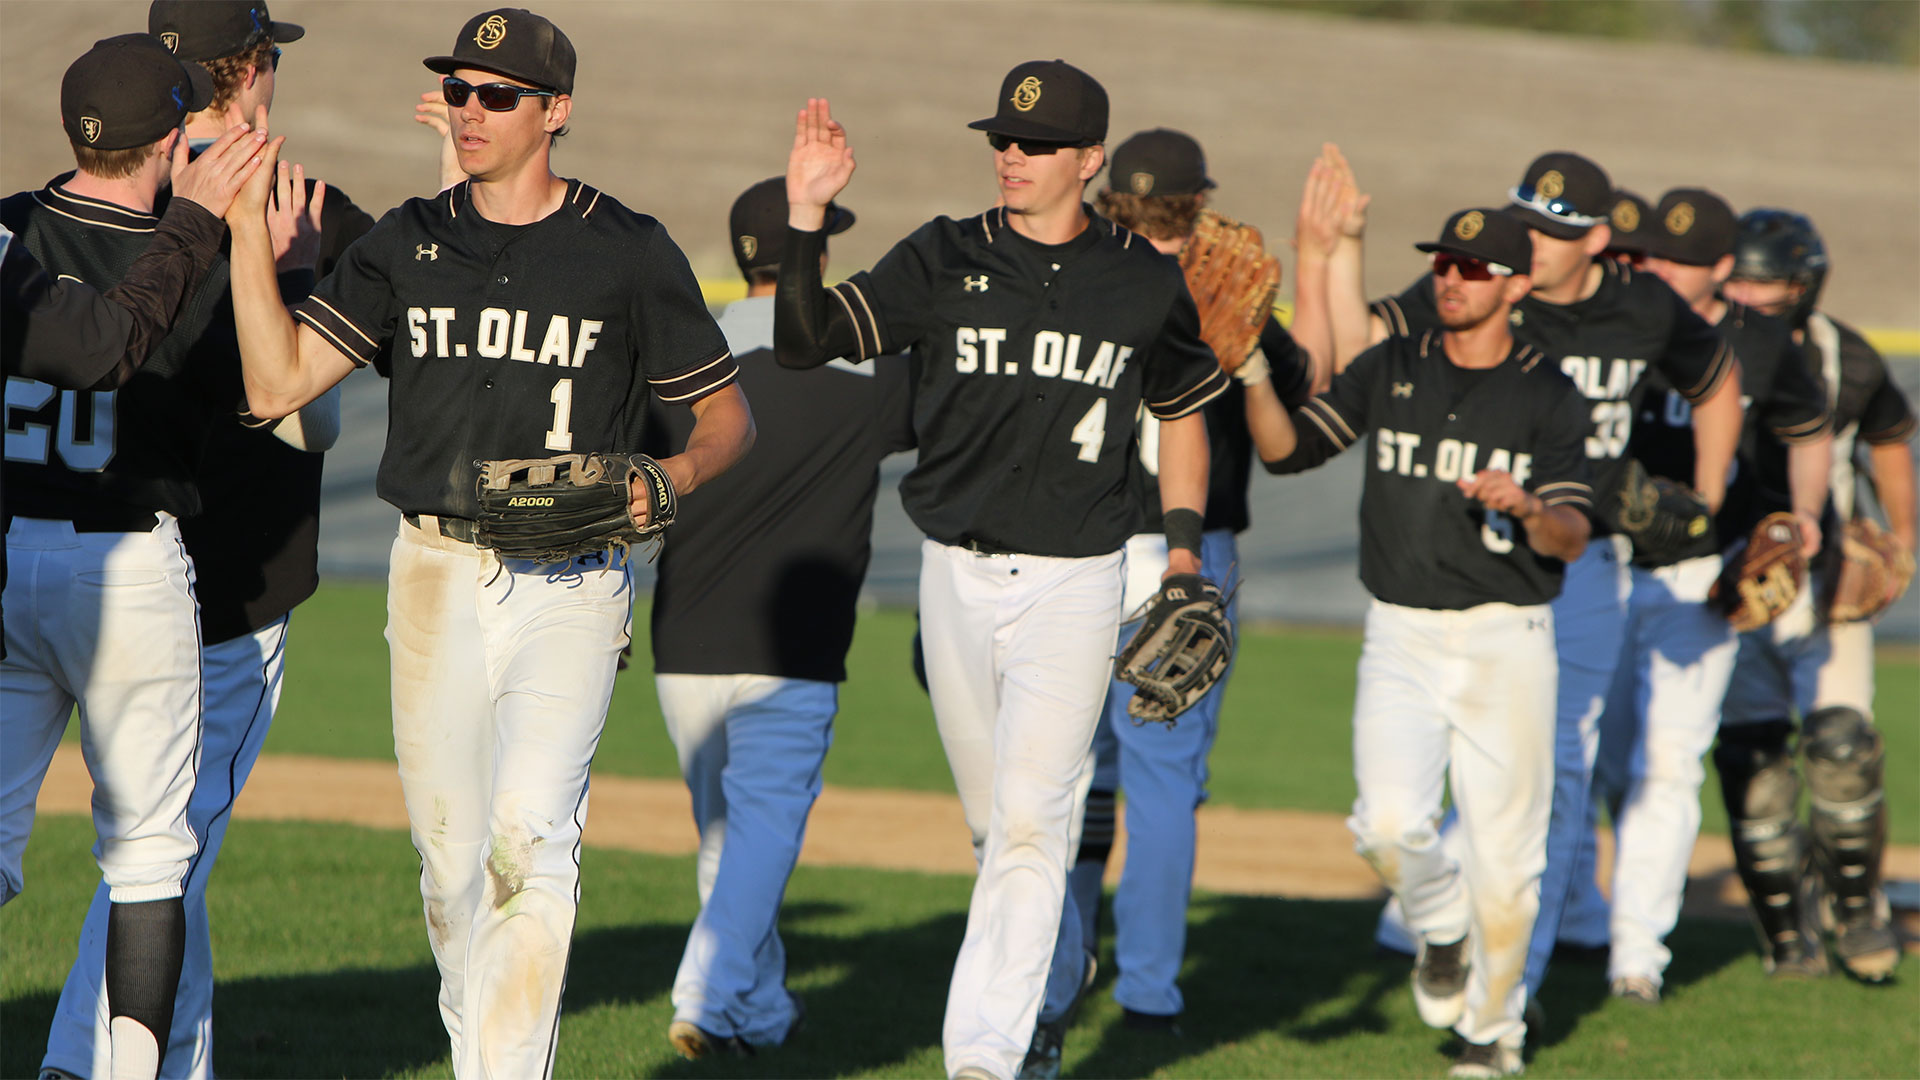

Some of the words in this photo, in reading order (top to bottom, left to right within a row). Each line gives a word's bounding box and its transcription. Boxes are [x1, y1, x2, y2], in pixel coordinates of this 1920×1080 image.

[407, 306, 468, 358] ST.
[477, 307, 604, 368] OLAF
[955, 326, 1019, 376] ST.
[1031, 329, 1134, 390] OLAF
[4, 375, 118, 473] 20
[544, 378, 573, 451] 1
[1069, 397, 1108, 464] 4
[1584, 400, 1632, 459] 33
[1376, 427, 1428, 478] ST.
[507, 497, 555, 507] A2000
[643, 465, 668, 508] Wilson
